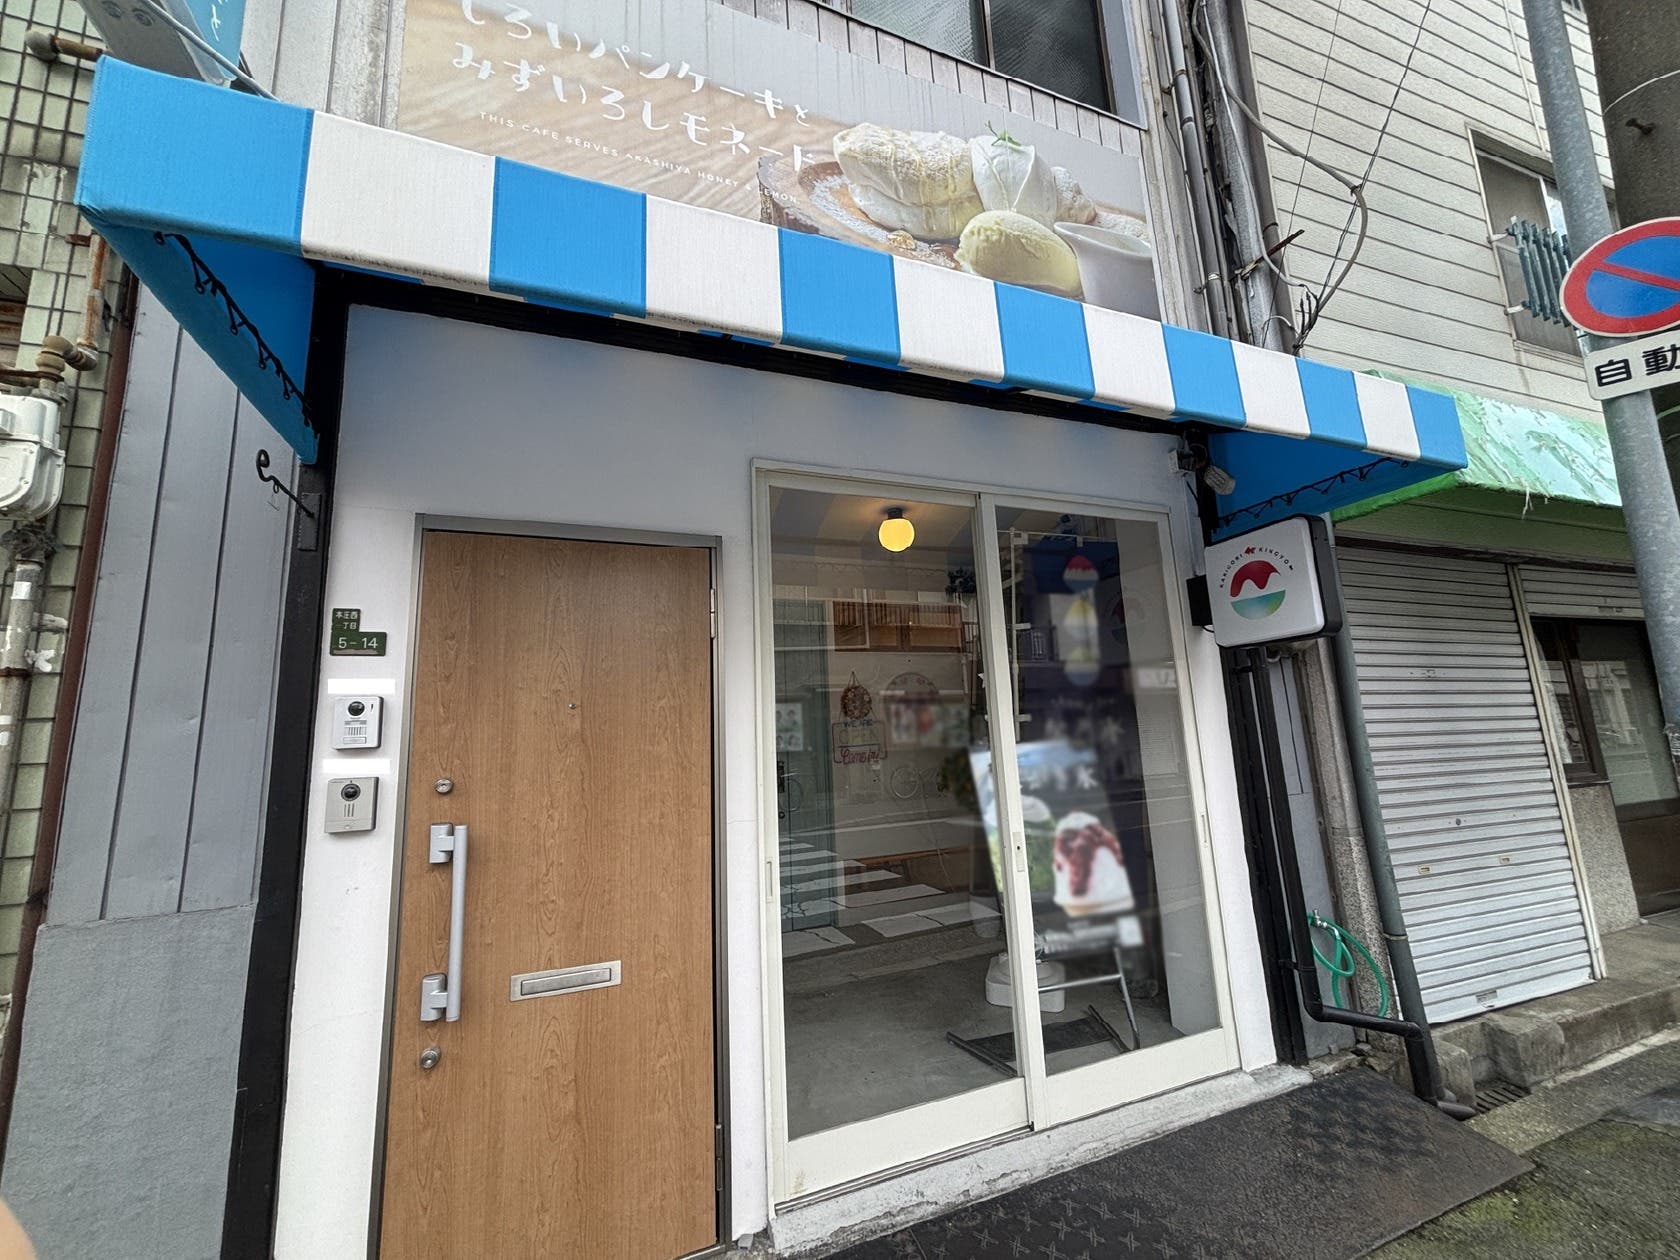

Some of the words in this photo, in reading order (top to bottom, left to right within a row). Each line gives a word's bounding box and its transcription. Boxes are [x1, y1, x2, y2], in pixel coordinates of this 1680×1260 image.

[480, 111, 514, 128] THIS
[521, 124, 559, 141] CAFE
[565, 135, 618, 157] SERVES
[624, 152, 691, 175] AKASHIYA
[697, 170, 739, 188] HONEY
[338, 637, 379, 649] 5-14
